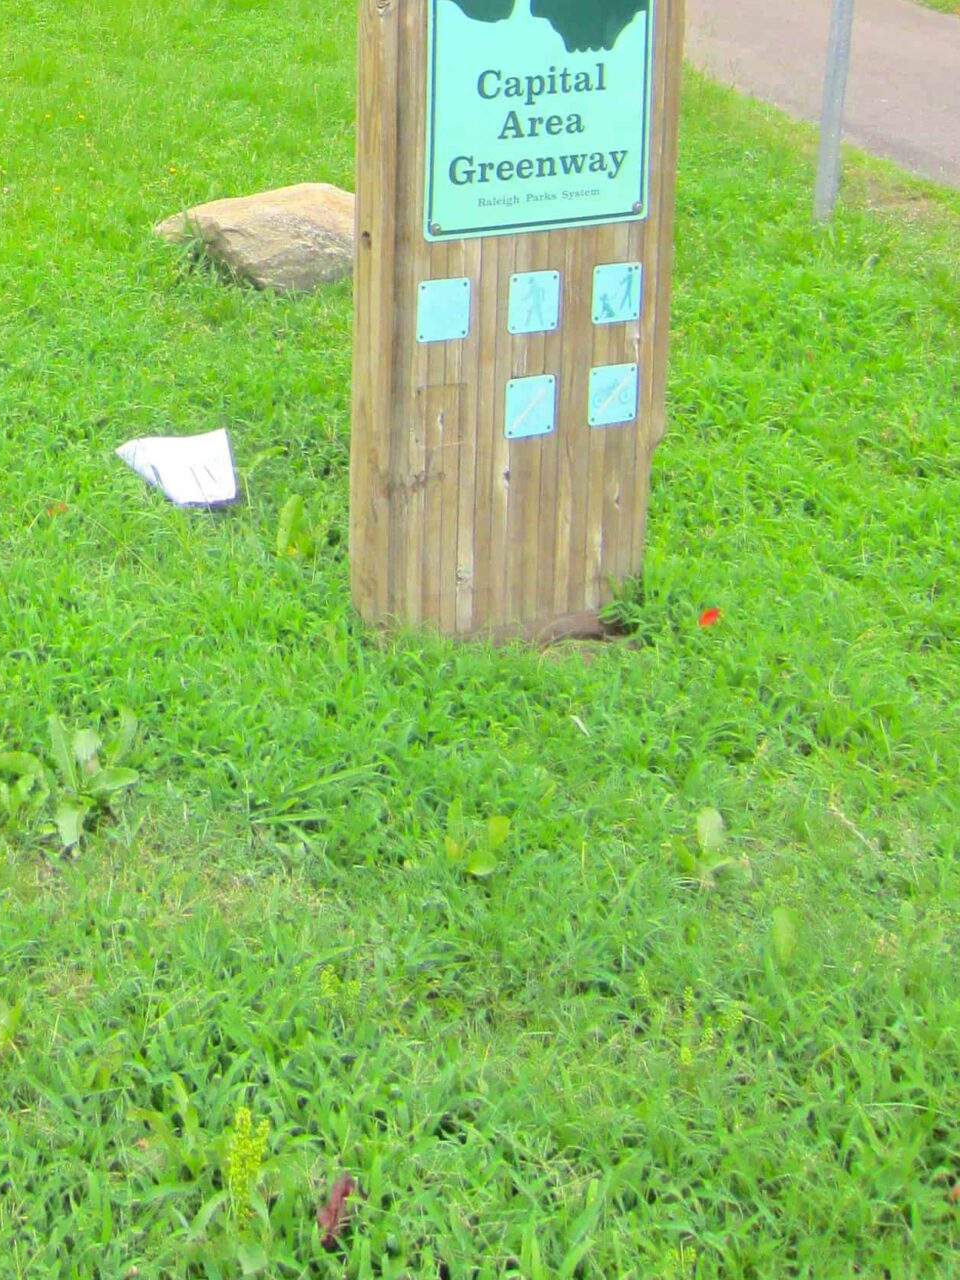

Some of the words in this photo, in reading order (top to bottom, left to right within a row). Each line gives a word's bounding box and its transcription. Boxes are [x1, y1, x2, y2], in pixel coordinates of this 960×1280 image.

[476, 62, 607, 105] Capital
[497, 110, 585, 140] Area
[448, 149, 628, 186] Greenway
[477, 195, 520, 208] Raleigh
[526, 192, 557, 203] Parks
[561, 187, 600, 200] System
